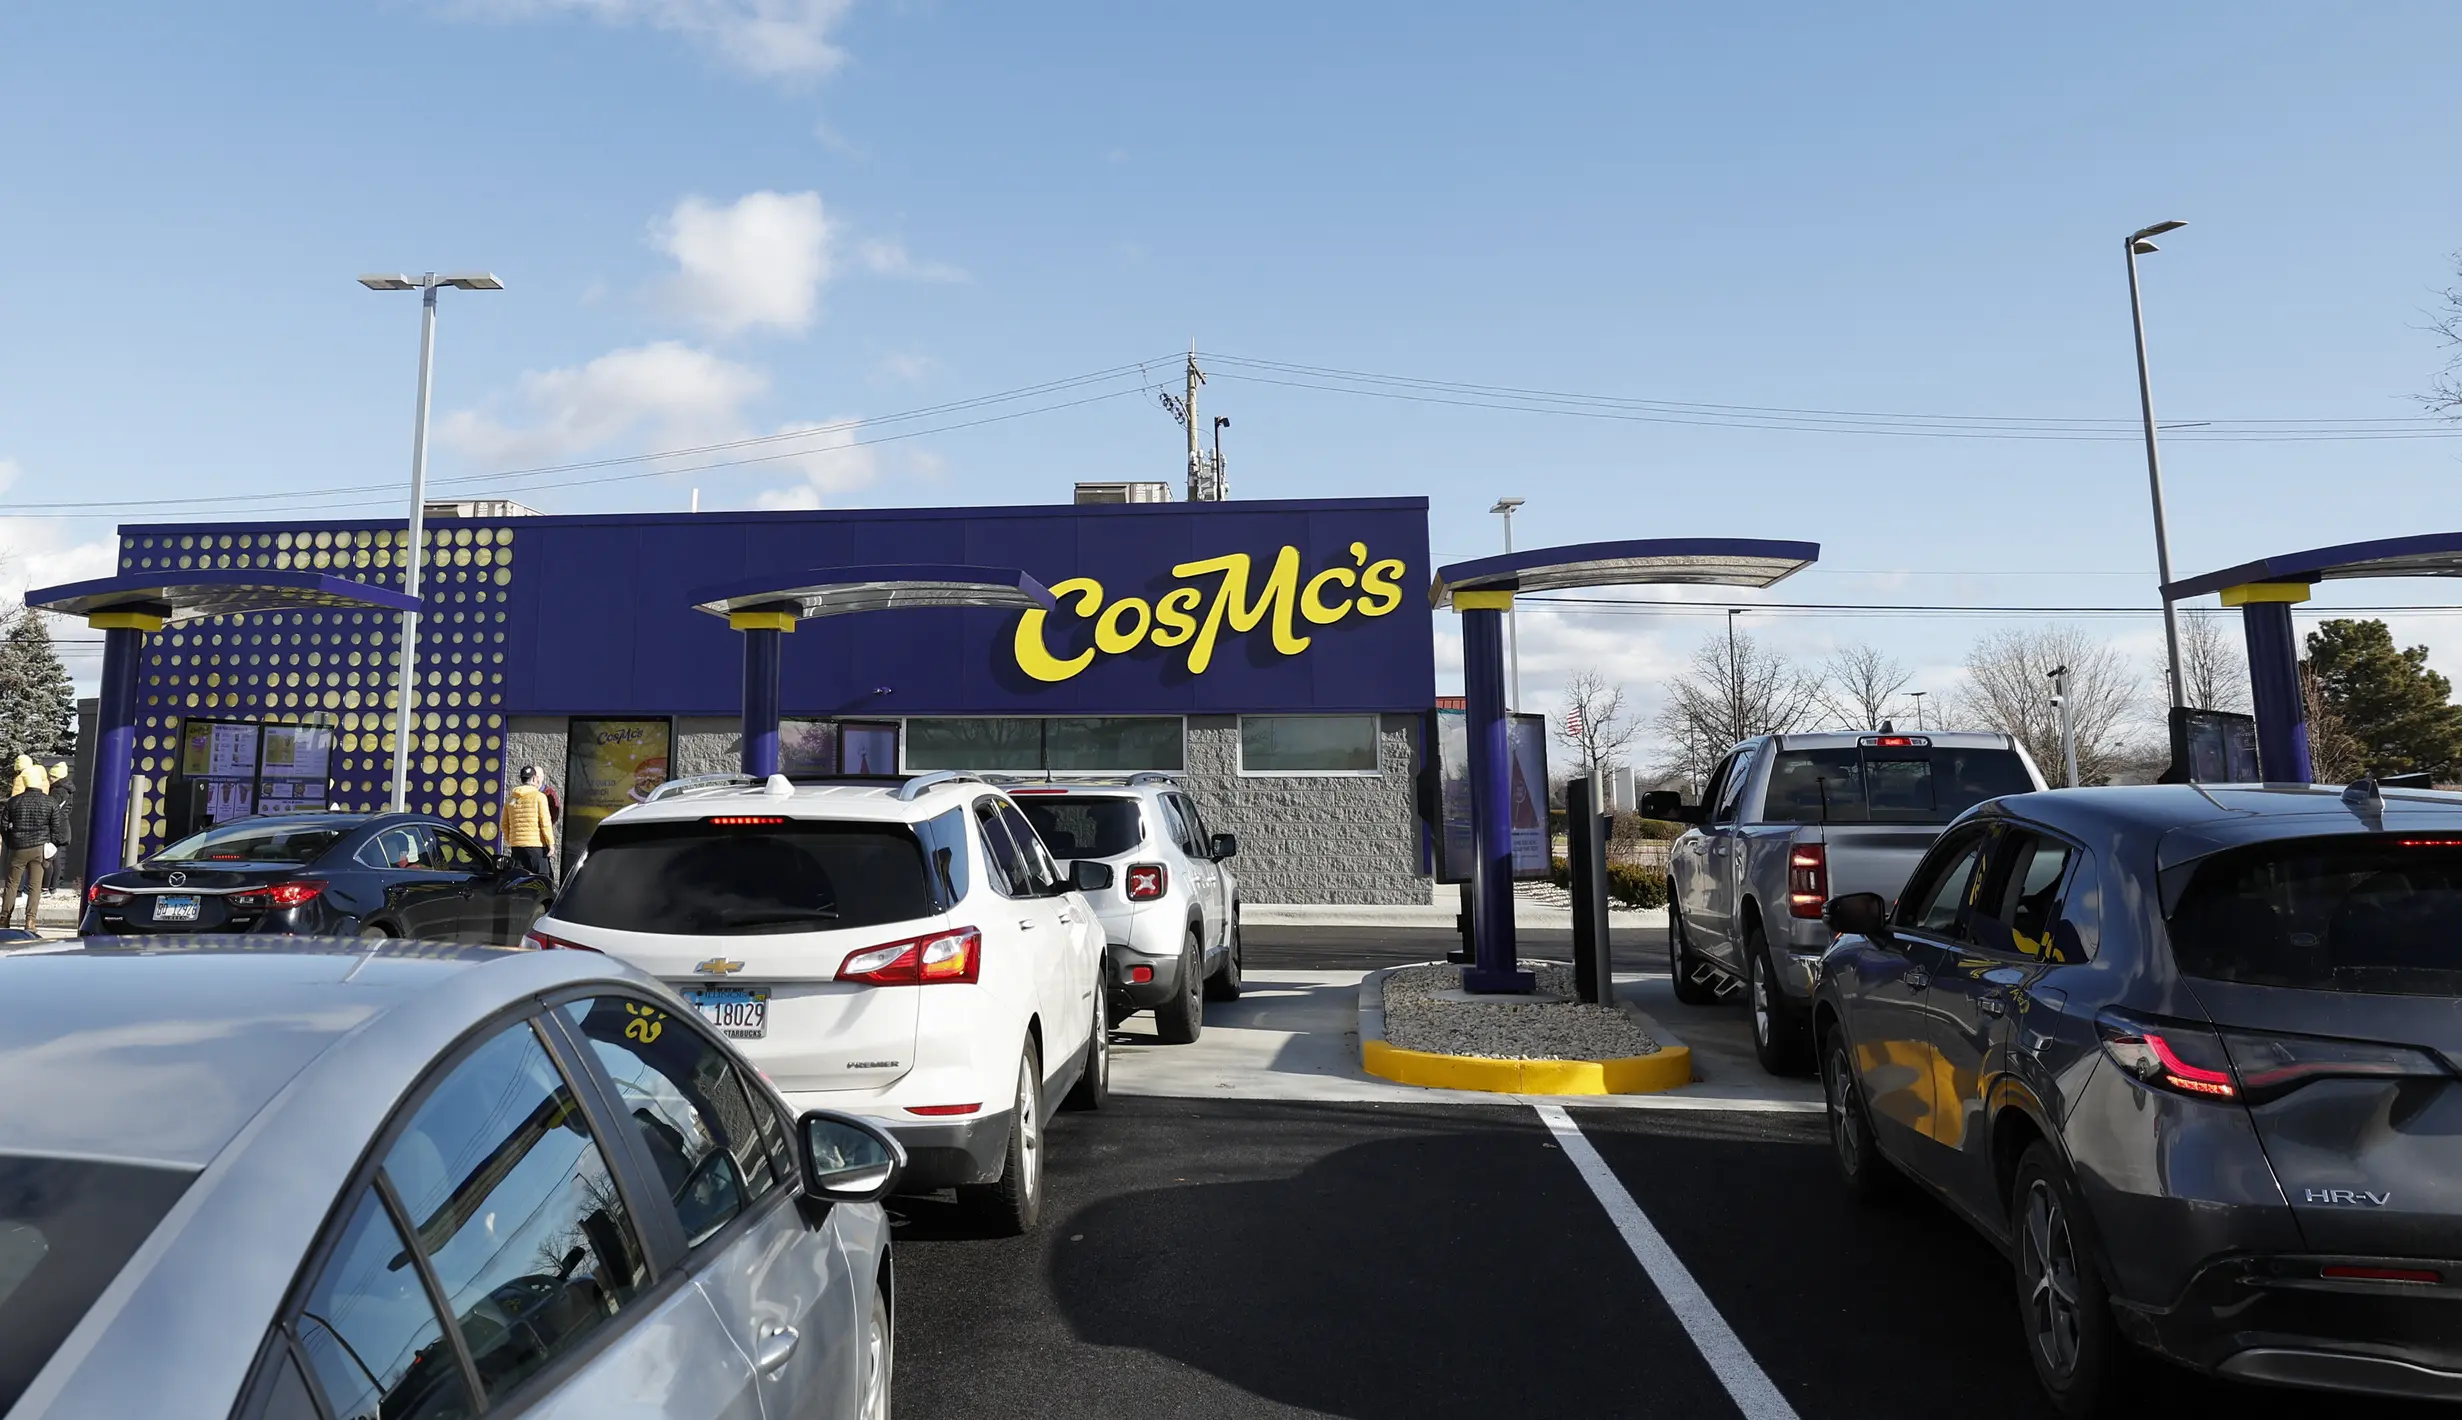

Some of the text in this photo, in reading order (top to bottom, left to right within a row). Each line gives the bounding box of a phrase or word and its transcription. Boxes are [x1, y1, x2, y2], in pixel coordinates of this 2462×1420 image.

[1014, 541, 1406, 682] CosMc's
[705, 991, 749, 999] ILLINOIS
[714, 1002, 766, 1027] 18029
[723, 1029, 762, 1037] STARBUCKS
[846, 1061, 900, 1070] PREMIER
[2304, 1188, 2391, 1205] HR-V
